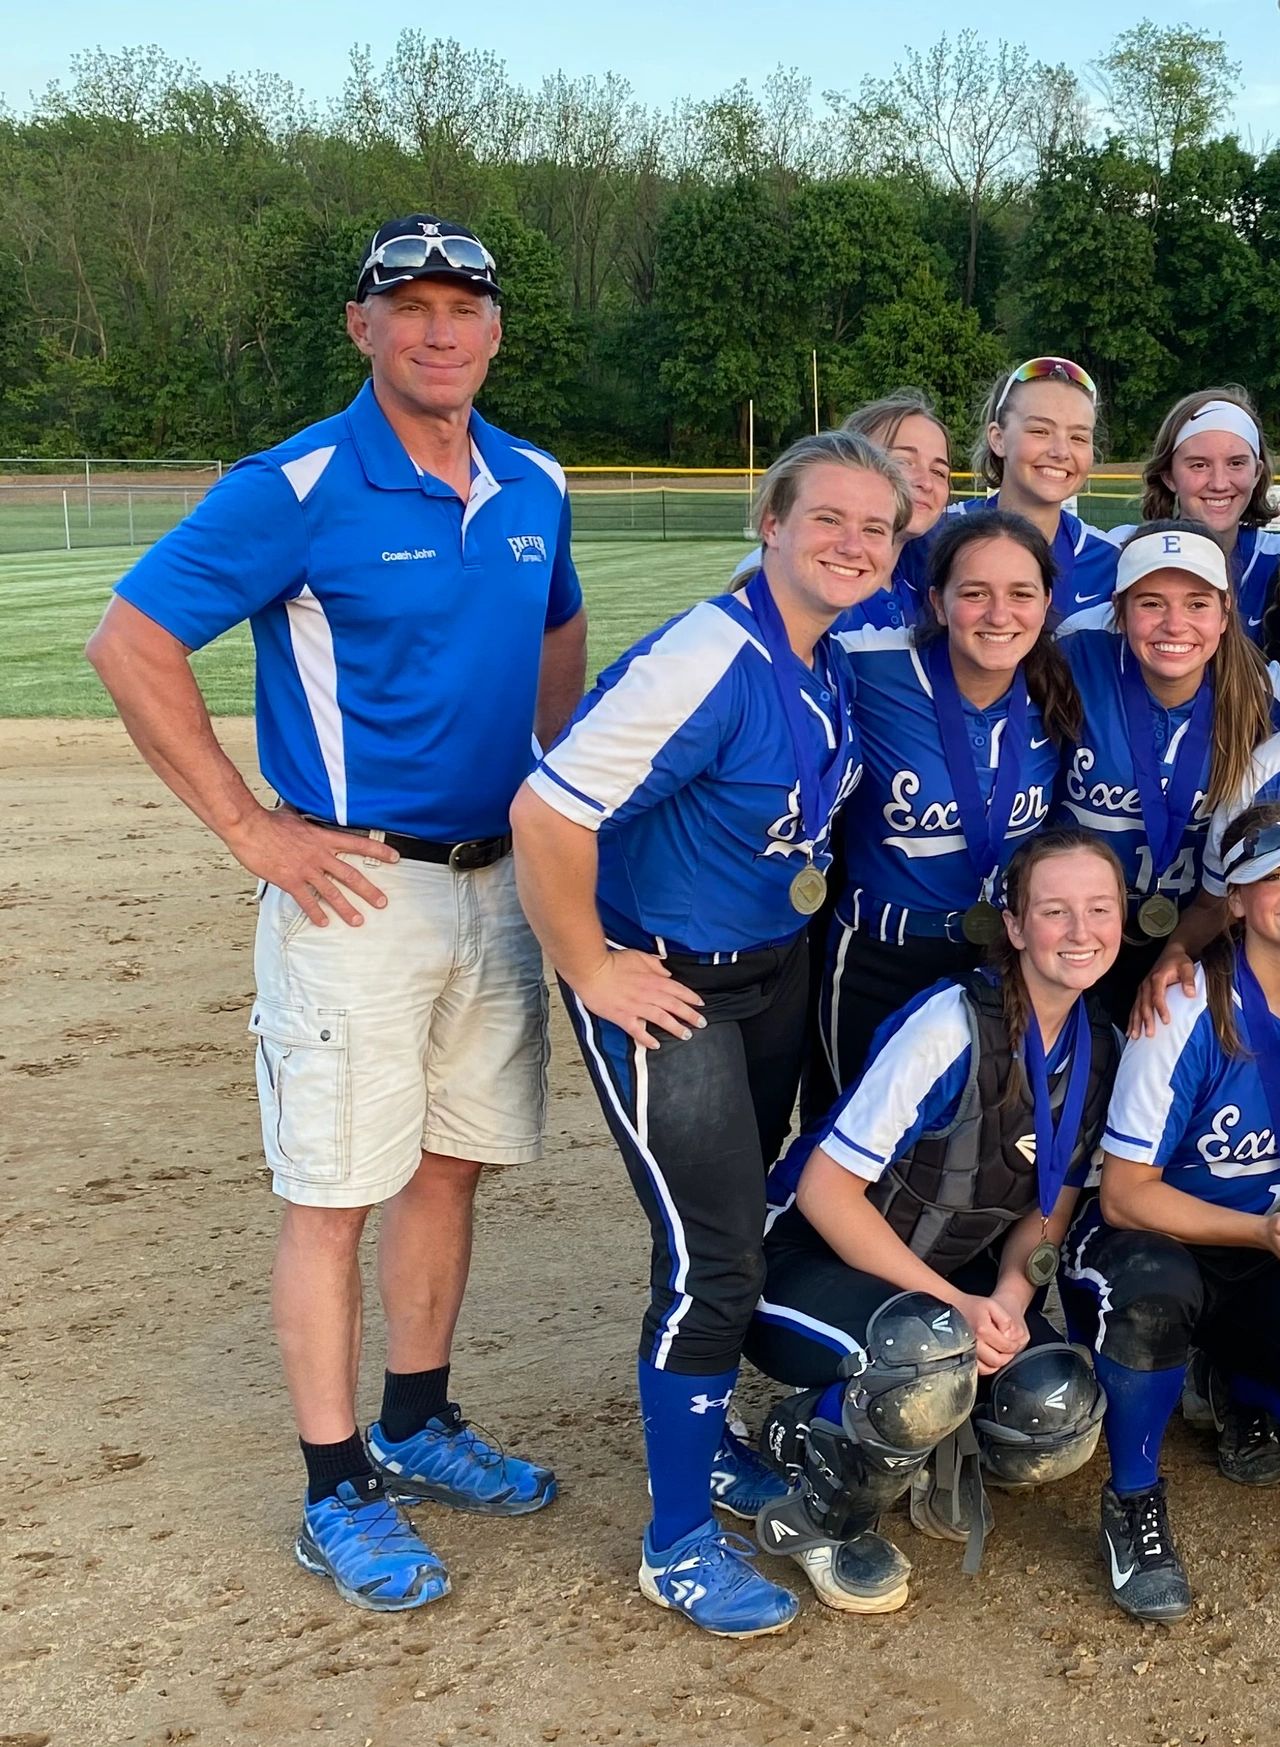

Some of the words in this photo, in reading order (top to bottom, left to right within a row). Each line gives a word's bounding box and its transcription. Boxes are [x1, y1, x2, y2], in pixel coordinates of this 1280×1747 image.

[1162, 535, 1181, 553] E
[382, 551, 412, 562] Coach
[413, 548, 437, 560] John
[1135, 845, 1196, 896] 14
